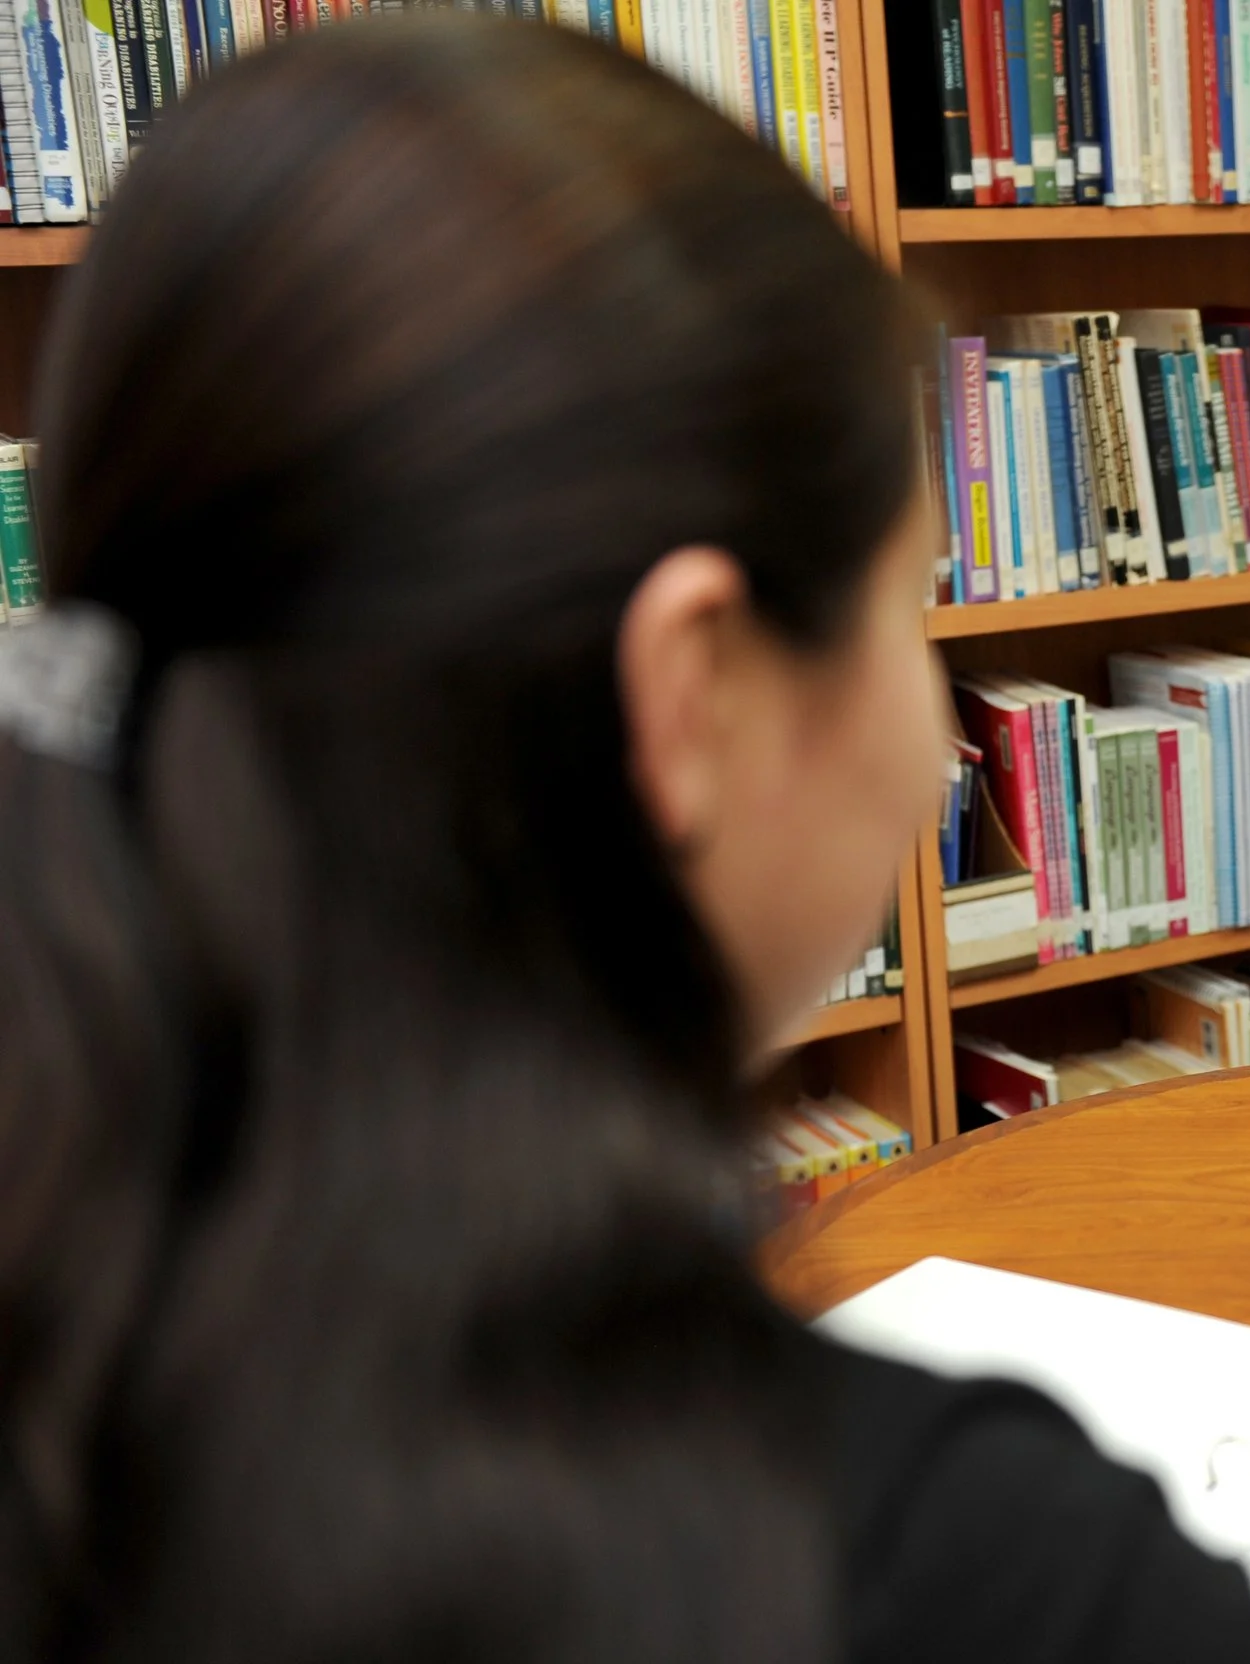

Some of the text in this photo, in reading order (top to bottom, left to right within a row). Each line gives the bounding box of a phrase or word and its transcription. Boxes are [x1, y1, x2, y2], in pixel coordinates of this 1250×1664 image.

[37, 38, 50, 82] Learning
[113, 0, 136, 110] EARNING DISABILITIES
[141, 0, 163, 108] EARNING DISABILITIES
[942, 41, 953, 90] READING
[43, 84, 57, 136] Disabilities
[826, 68, 842, 119] Guide
[1053, 76, 1066, 96] Still
[964, 351, 986, 467] INVITATIONS
[1211, 392, 1232, 465] READING
